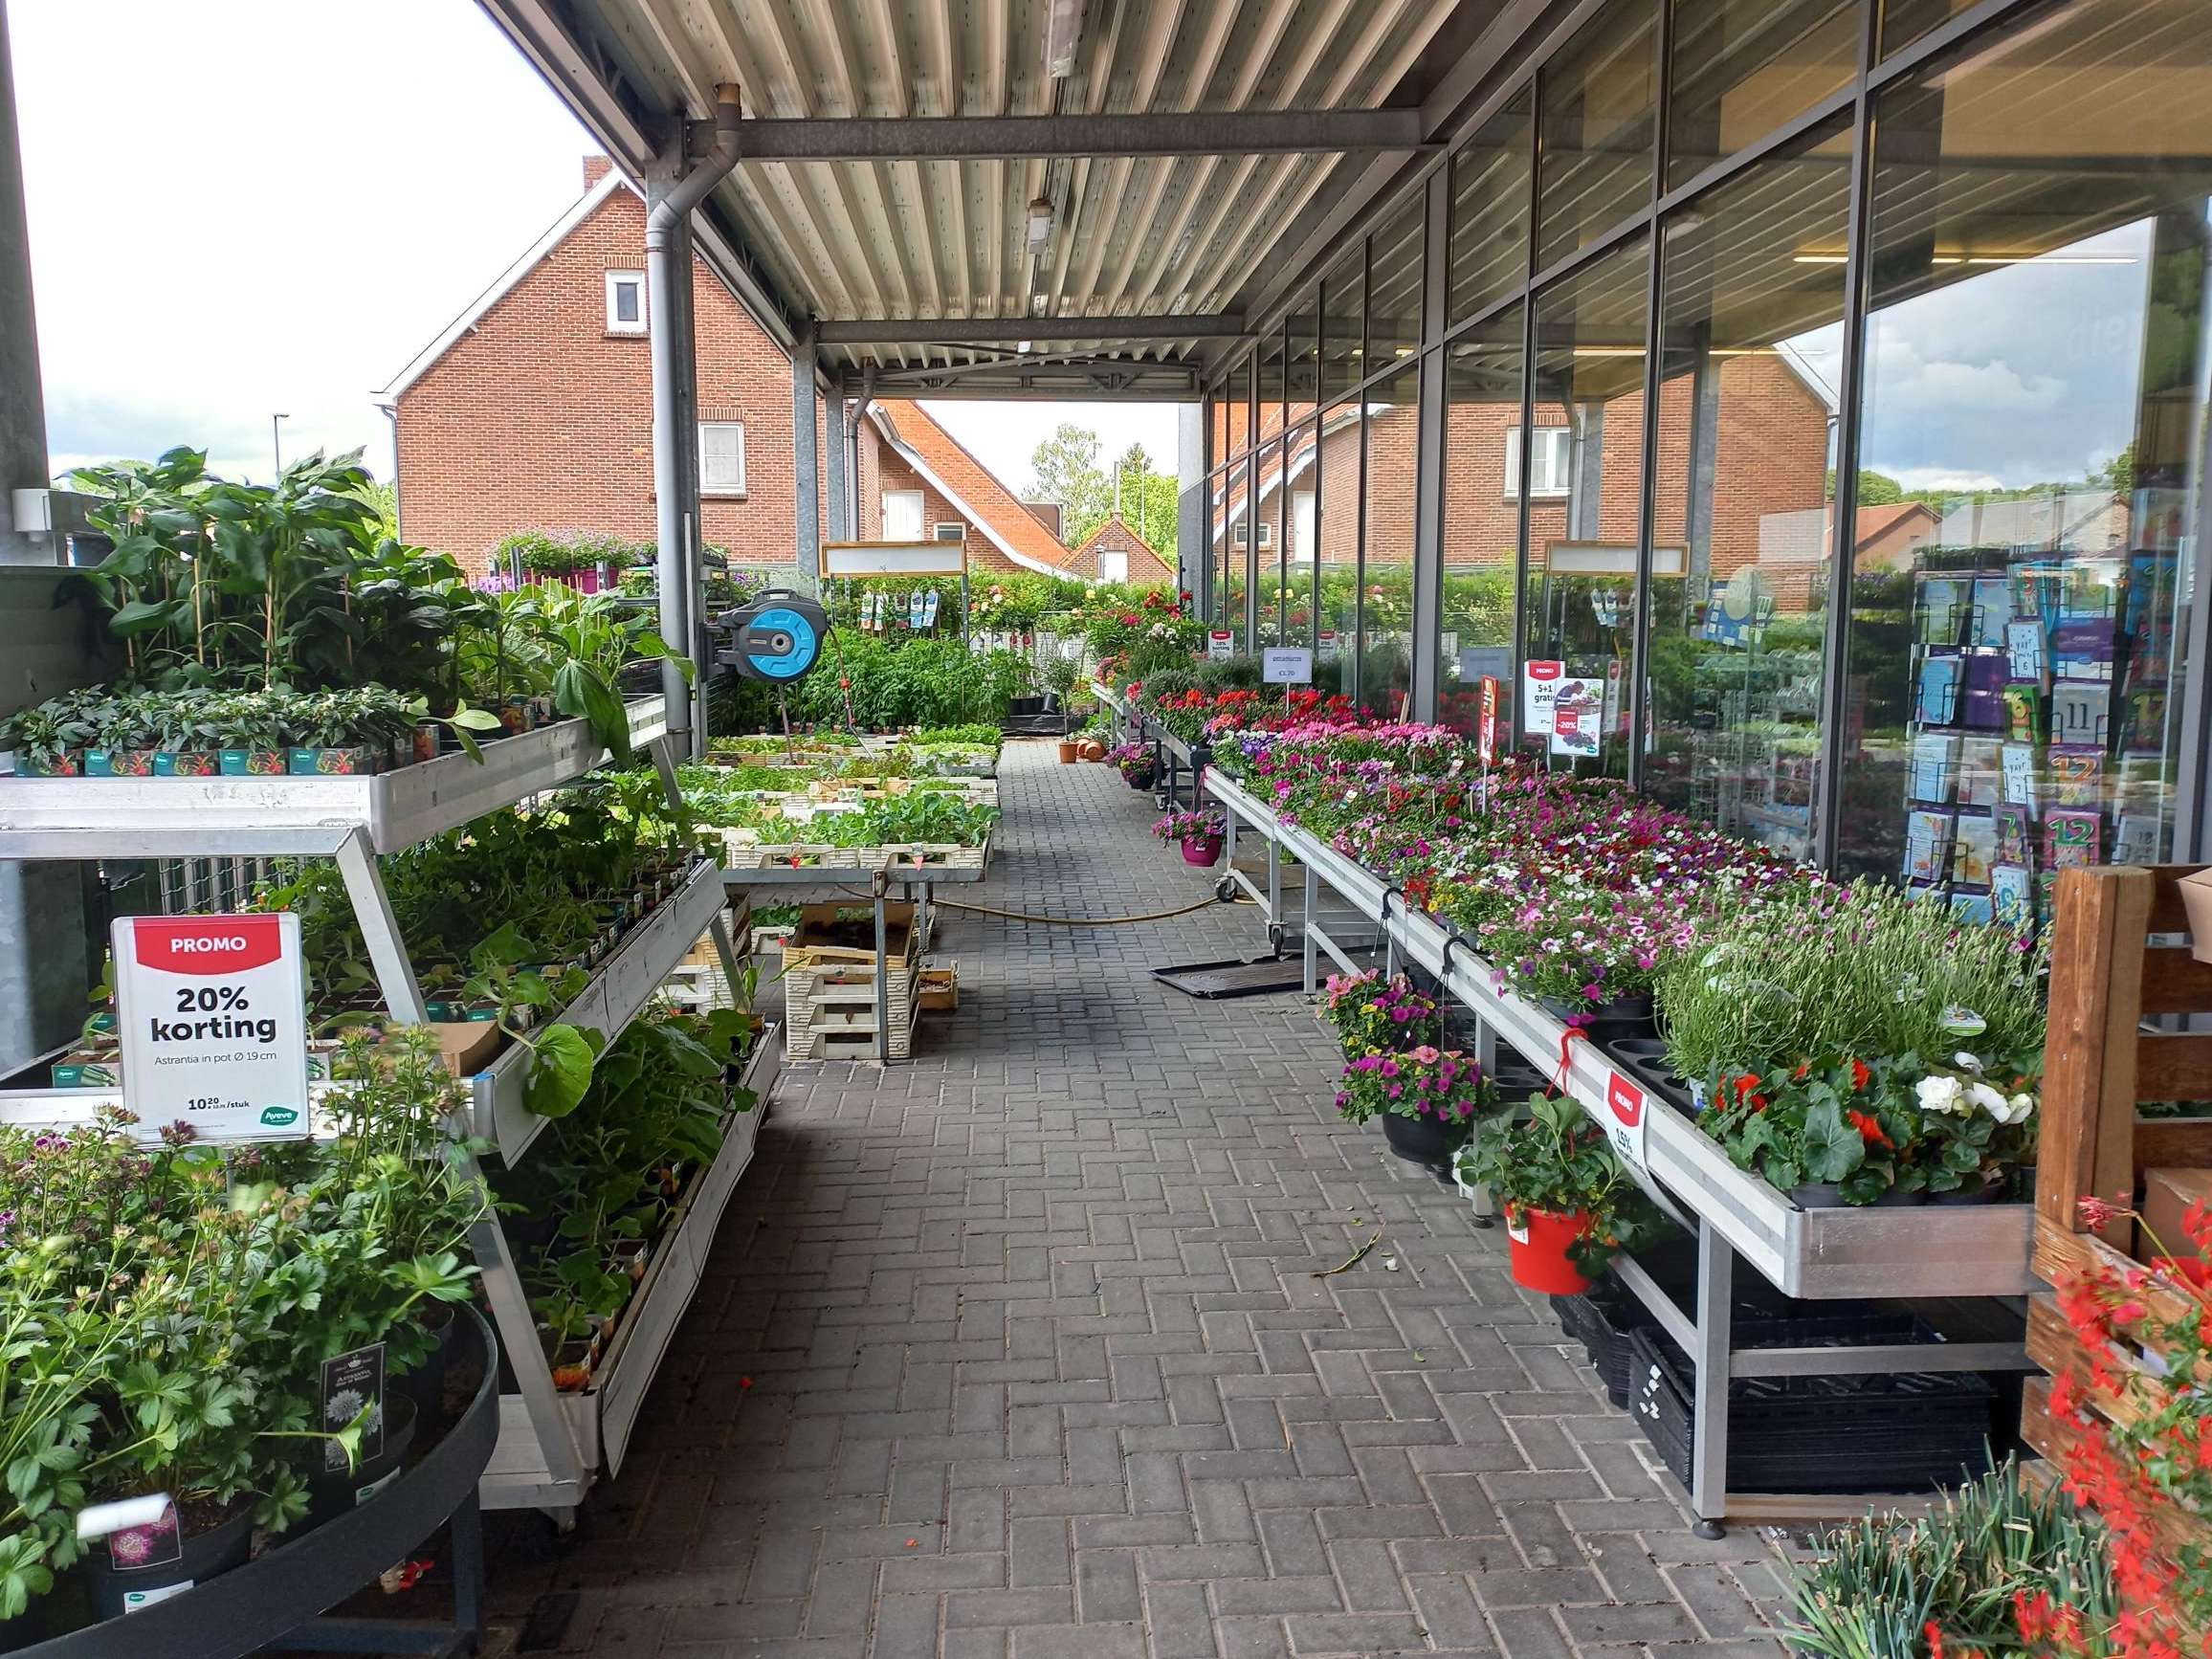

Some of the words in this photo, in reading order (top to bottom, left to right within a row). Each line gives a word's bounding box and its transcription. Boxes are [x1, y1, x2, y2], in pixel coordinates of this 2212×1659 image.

[1537, 684, 1552, 693] 5+1
[2067, 702, 2090, 730] 11
[2051, 754, 2097, 782] 12
[2002, 815, 2016, 838] 7
[2048, 818, 2094, 846] 12
[170, 937, 246, 953] PROMO
[176, 985, 249, 1012] 20%
[151, 1014, 276, 1043] korting
[154, 1055, 199, 1065] Astrantia
[202, 1054, 211, 1063] in
[213, 1054, 232, 1064] pot
[246, 1051, 258, 1061] 19
[1614, 1090, 1634, 1113] PROMO
[265, 1112, 293, 1120] Aveve
